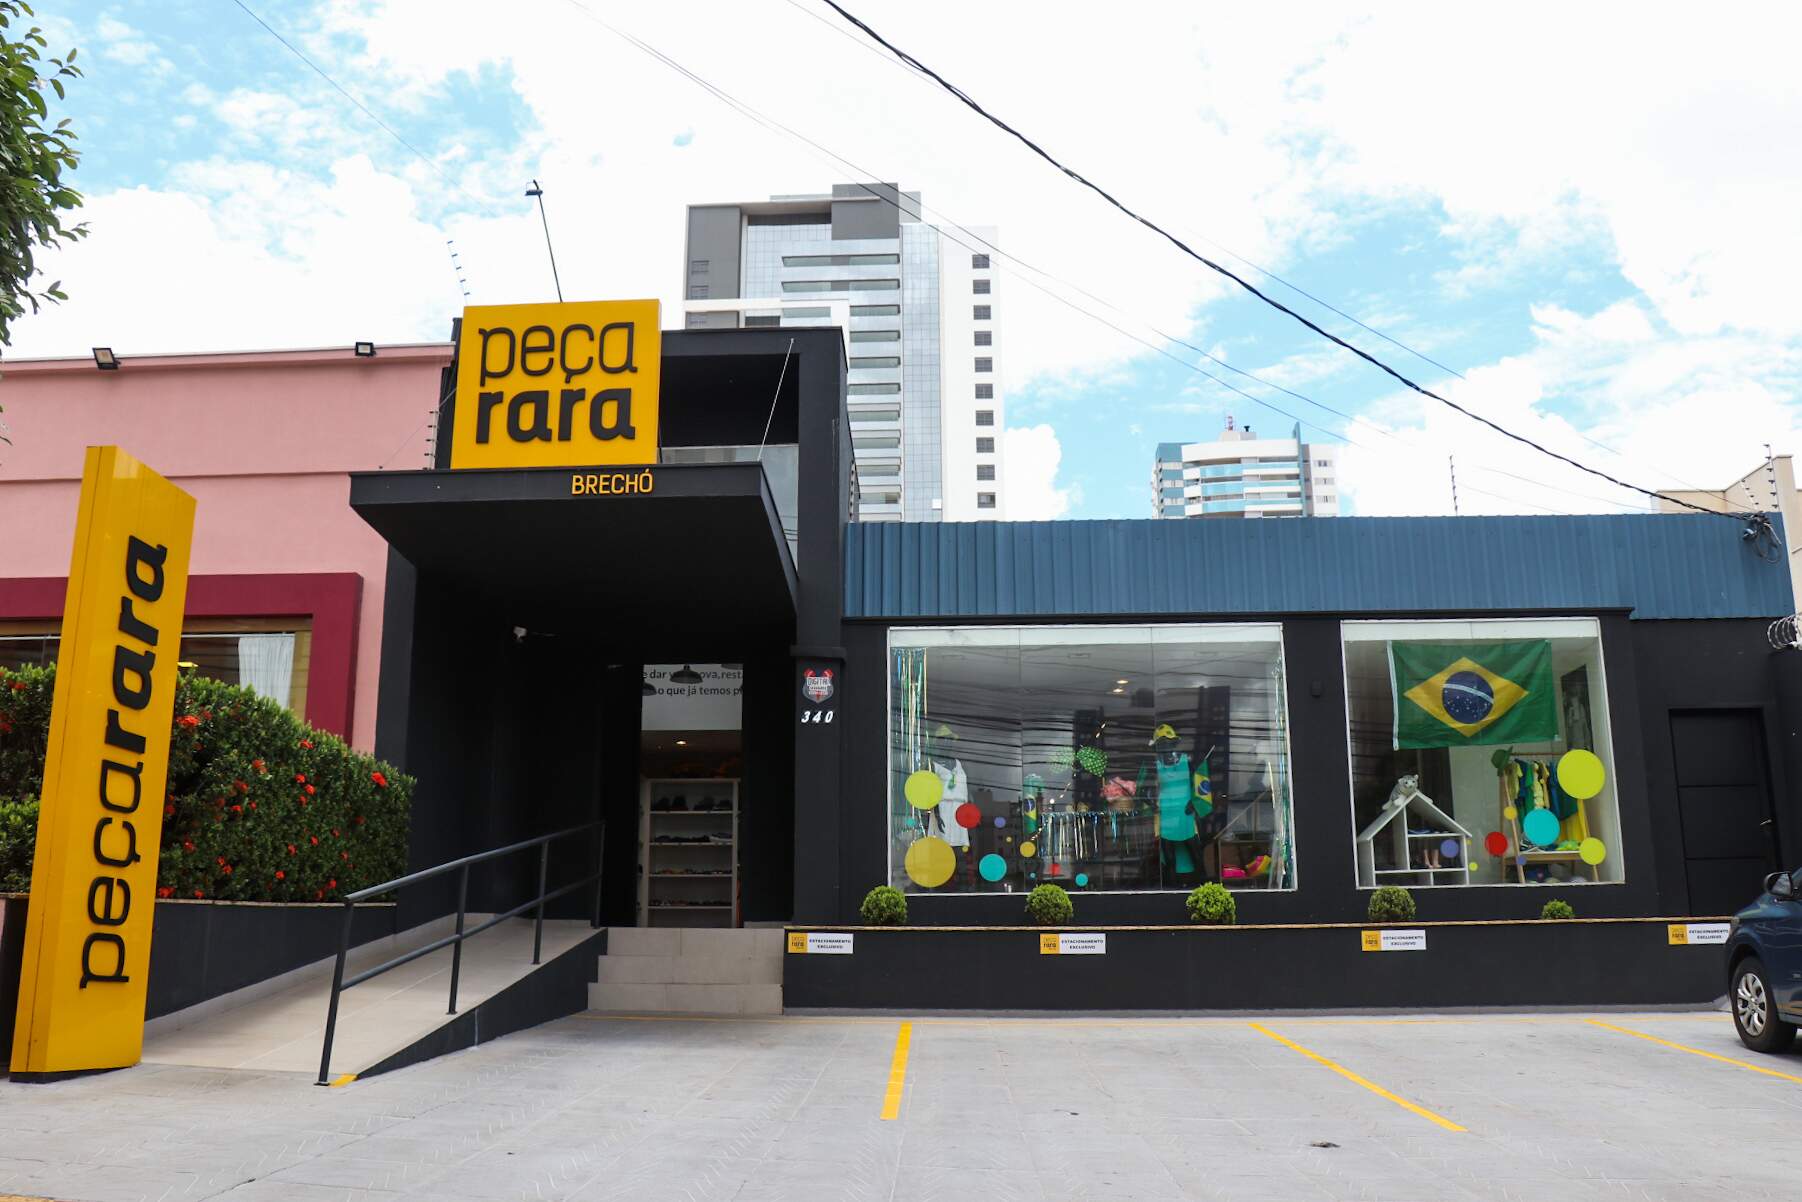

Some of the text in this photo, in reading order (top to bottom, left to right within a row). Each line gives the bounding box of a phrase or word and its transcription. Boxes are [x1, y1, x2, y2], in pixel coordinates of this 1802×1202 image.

[478, 322, 638, 387] peça
[475, 387, 636, 444] rara
[571, 468, 654, 495] BRECHÓ
[649, 669, 666, 679] dar
[666, 687, 686, 697] que
[687, 685, 697, 697] já
[699, 686, 731, 695] temos
[801, 710, 834, 723] 340
